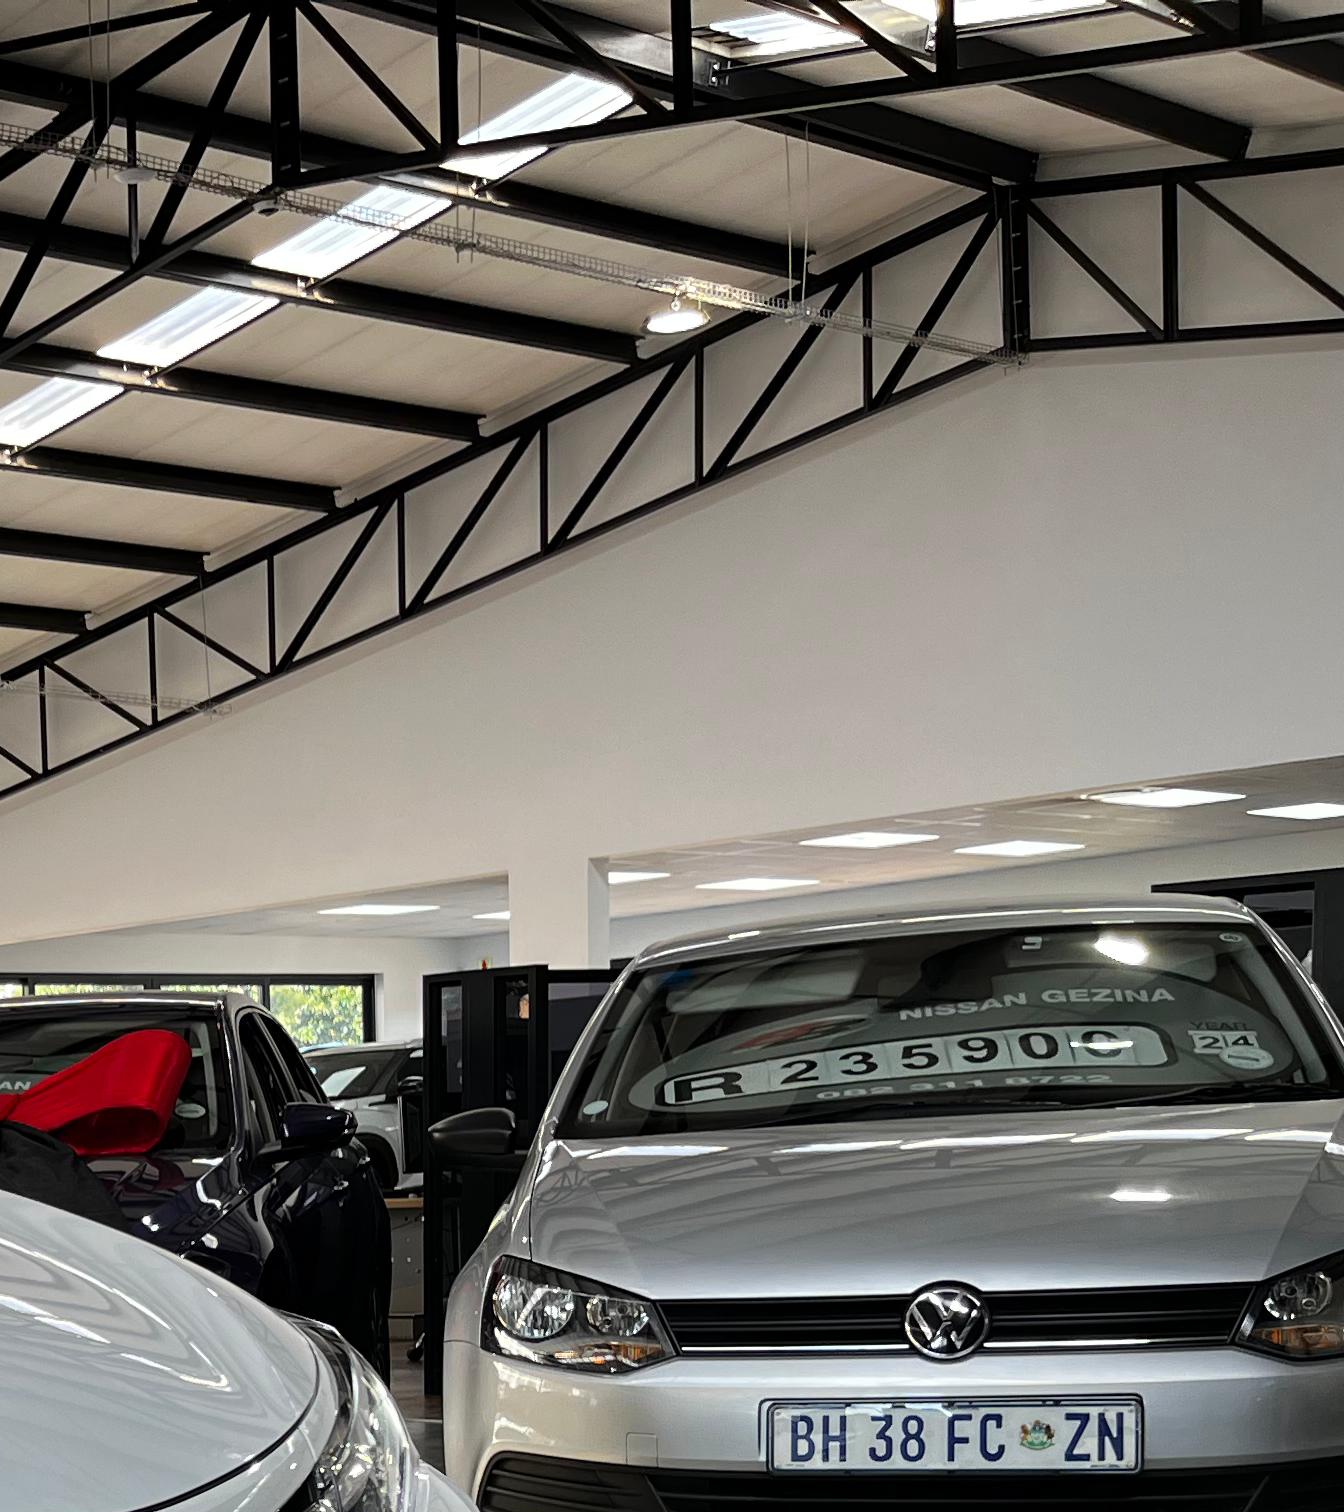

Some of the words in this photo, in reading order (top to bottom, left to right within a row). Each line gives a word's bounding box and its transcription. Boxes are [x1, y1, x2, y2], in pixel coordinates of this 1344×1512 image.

[899, 992, 1026, 1020] NISSAN
[1041, 988, 1175, 1002] GEZINA
[1198, 1035, 1255, 1049] 24
[673, 1071, 744, 1103] R
[790, 1414, 847, 1462] BH
[868, 1414, 926, 1463] 38
[946, 1413, 1006, 1462] FC
[1064, 1411, 1124, 1462] ZN
